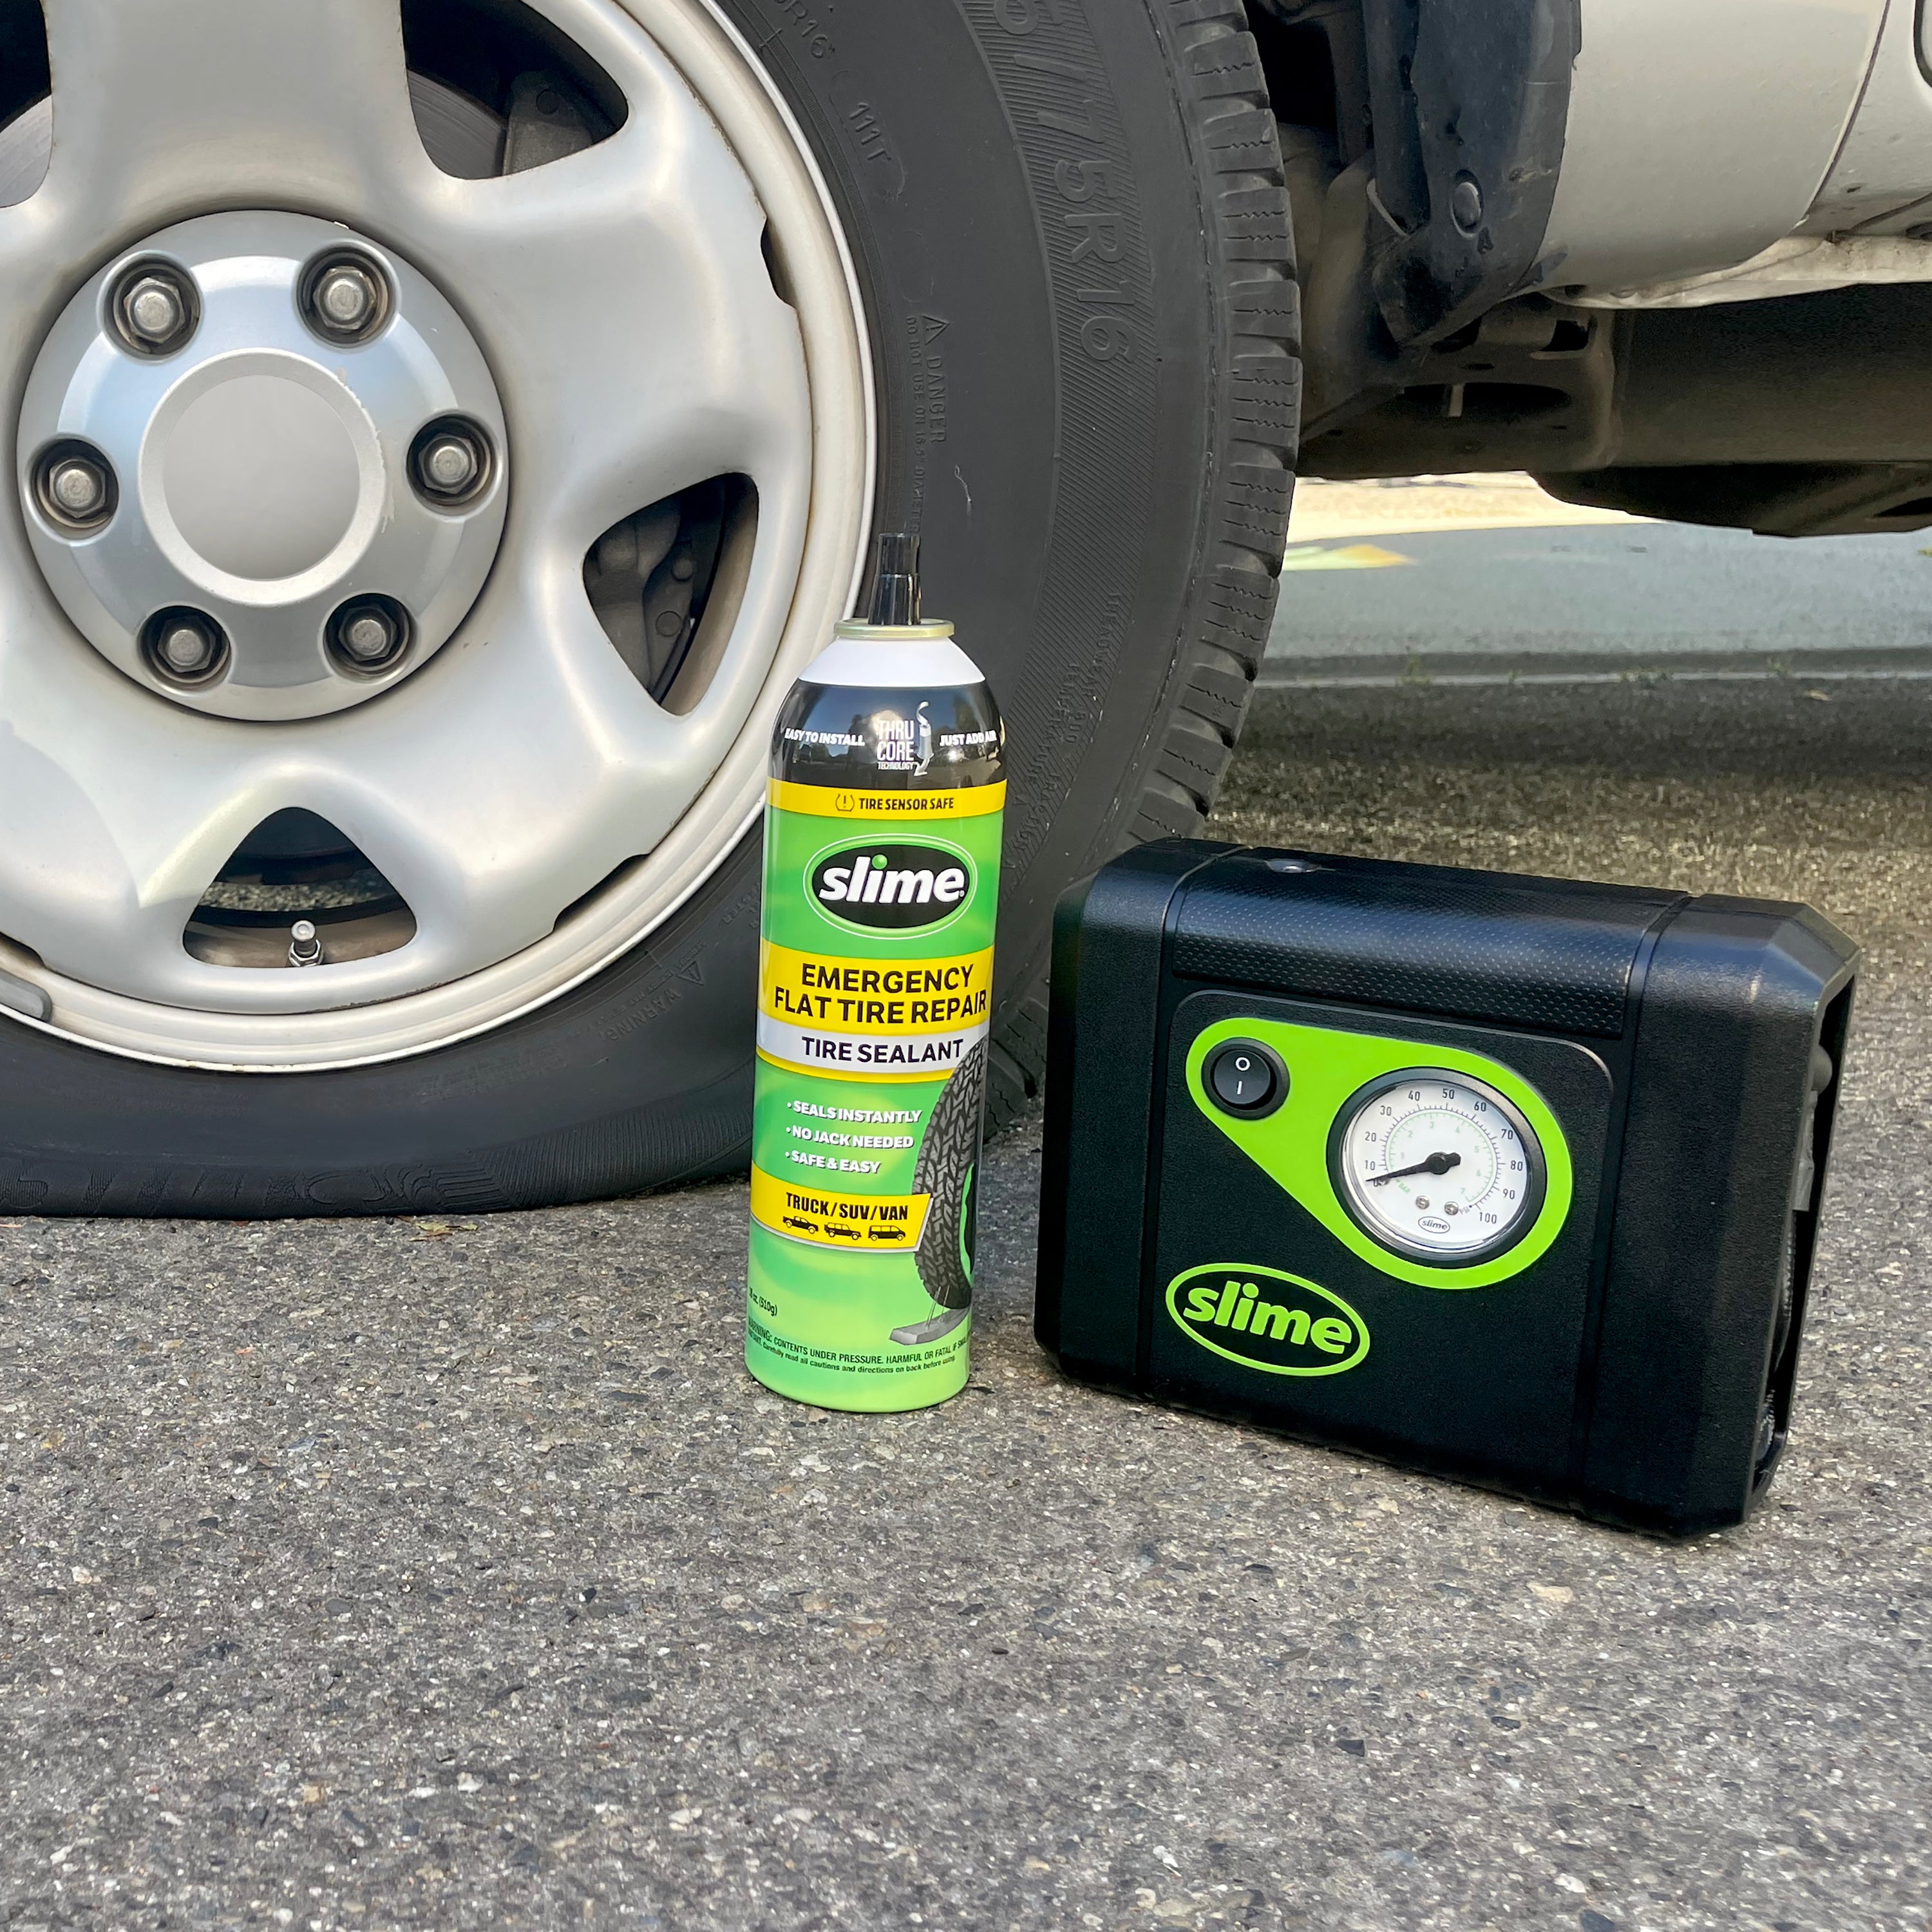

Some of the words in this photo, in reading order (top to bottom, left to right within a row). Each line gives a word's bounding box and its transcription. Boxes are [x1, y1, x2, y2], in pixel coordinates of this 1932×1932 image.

[926, 355, 947, 444] DANGER
[784, 728, 805, 741] EASY
[806, 731, 819, 743] TO
[819, 733, 866, 746] INSTALL
[877, 720, 914, 740] THRU
[940, 734, 965, 746] JUST
[965, 732, 985, 745] ADD
[876, 741, 914, 762] CORE
[877, 761, 914, 770] TECHNOLOGY
[858, 797, 883, 810] TIRE
[885, 798, 928, 811] SENSOR
[929, 797, 954, 810] SAFE
[818, 854, 966, 904] slime
[801, 963, 974, 993] EMERGENCY
[606, 987, 685, 1041] WARNING
[774, 986, 832, 1019] FLAT
[837, 998, 904, 1024] TIRE
[911, 989, 987, 1024] REPAIR
[801, 1036, 853, 1061] TIRE
[856, 1038, 964, 1064] SEALANT
[1408, 1090, 1421, 1102] 40
[1442, 1088, 1455, 1100] 50
[792, 1100, 837, 1121] SEALS
[838, 1108, 923, 1124] INSTANTLY
[1379, 1105, 1392, 1116] 30
[1473, 1101, 1487, 1112] 60
[791, 1126, 813, 1141] NO
[812, 1131, 851, 1148] JACK
[851, 1135, 914, 1150] NEEDED
[1365, 1132, 1377, 1142] 20
[1501, 1128, 1513, 1140] 70
[790, 1150, 826, 1170] SAFE
[825, 1159, 838, 1171] &
[839, 1159, 882, 1175] EASY
[1364, 1160, 1376, 1171] 10
[1510, 1160, 1523, 1171] 80
[1502, 1189, 1515, 1200] 90
[1458, 1207, 1470, 1215] PSI
[1478, 1211, 1497, 1224] 100
[1421, 1218, 1448, 1231] slime
[759, 1296, 778, 1318] (510g)
[1182, 1280, 1352, 1354] slime
[773, 1336, 808, 1355] CONTENTS
[810, 1348, 837, 1361] UNDER
[838, 1353, 884, 1364] PRESSURE.
[886, 1353, 922, 1364] HARMFUL
[924, 1350, 934, 1360] OR
[935, 1345, 951, 1358] FATAL
[785, 1353, 799, 1362] read
[810, 1360, 840, 1370] cautions
[857, 1365, 894, 1374] directions
[923, 1361, 942, 1370] before
